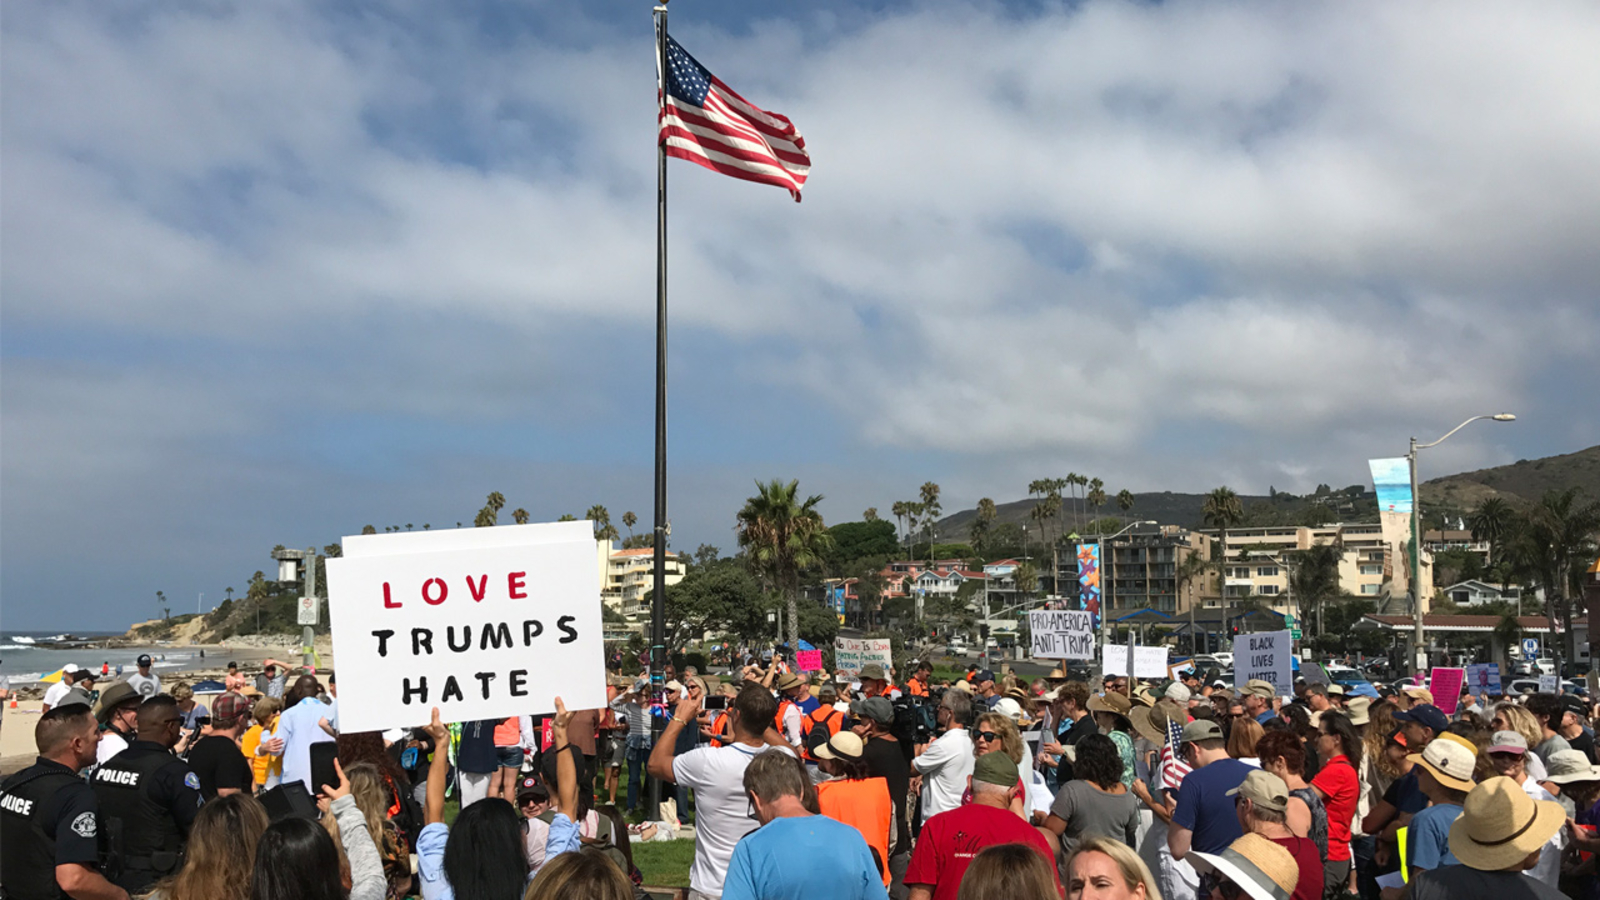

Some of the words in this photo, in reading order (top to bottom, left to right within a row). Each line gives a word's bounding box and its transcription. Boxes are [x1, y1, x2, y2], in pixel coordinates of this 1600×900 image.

[382, 571, 528, 609] LOVE
[1031, 613, 1092, 632] PRO-AMERICA
[371, 615, 578, 657] TRUMPS
[1034, 634, 1092, 655] ANTI-TRUMP
[1250, 637, 1274, 650] BLACK
[1251, 654, 1273, 667] LIVES
[402, 669, 529, 705] HATE
[96, 768, 139, 785] POLICE
